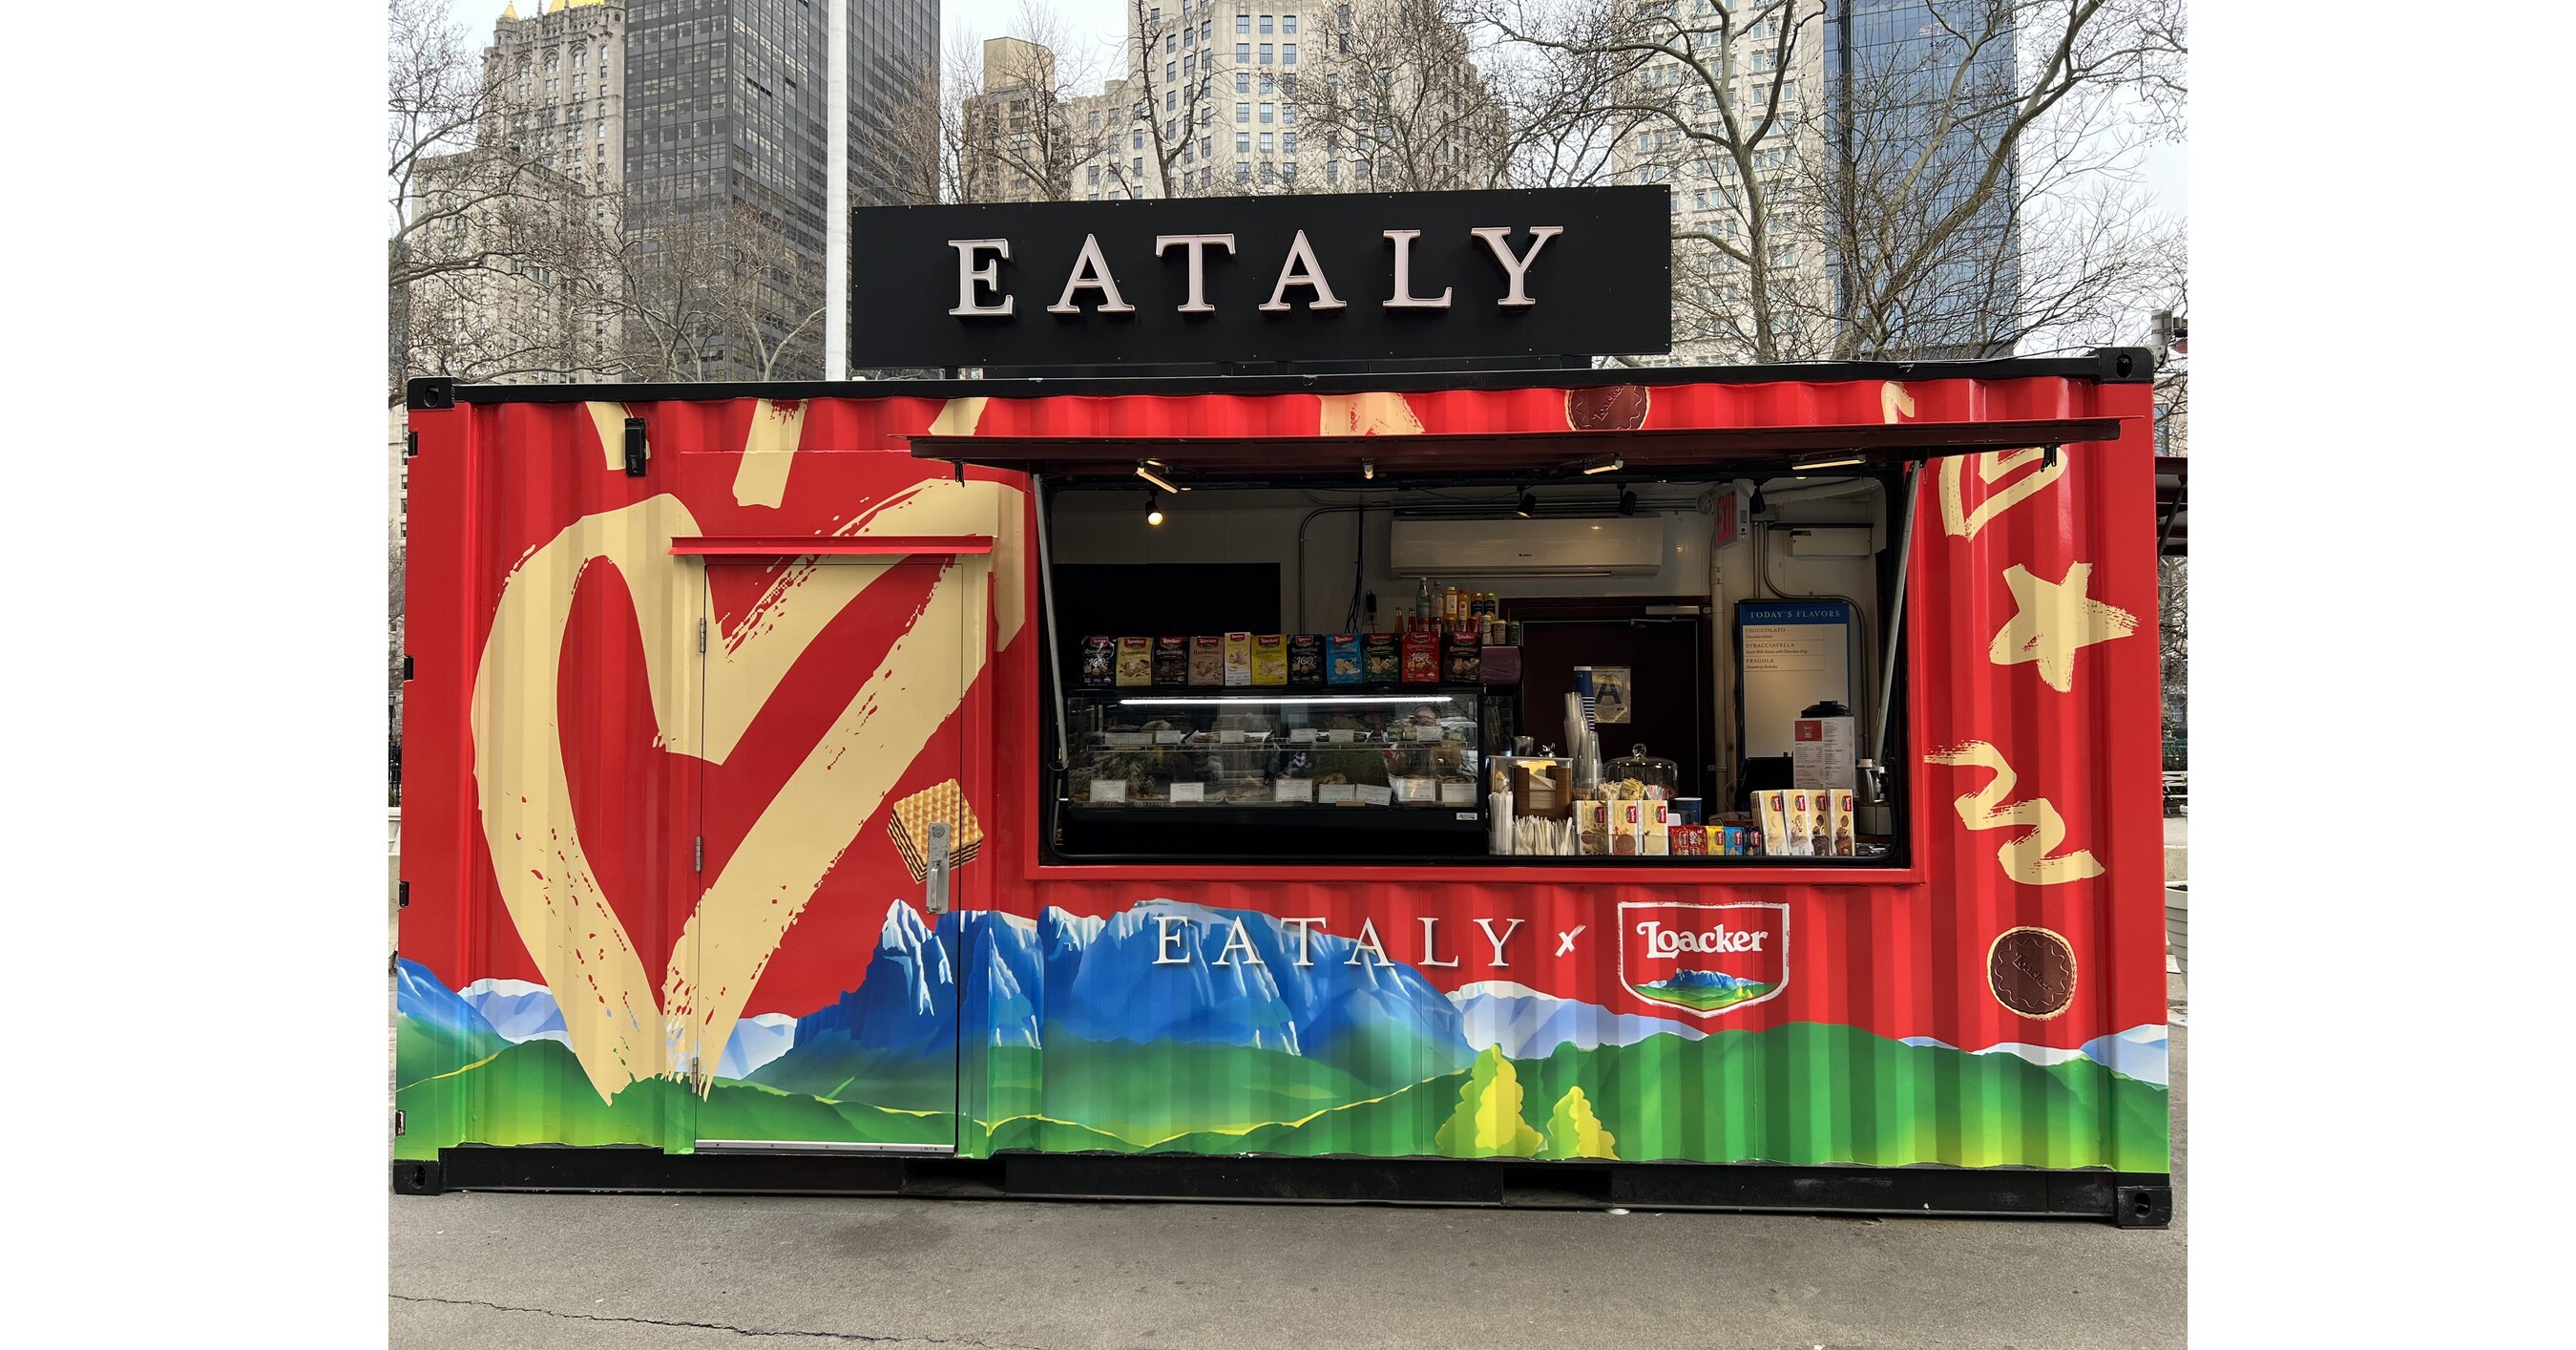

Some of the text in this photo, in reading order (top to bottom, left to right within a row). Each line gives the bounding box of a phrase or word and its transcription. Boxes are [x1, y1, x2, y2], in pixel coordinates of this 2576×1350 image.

[948, 225, 1564, 317] EATALY
[1591, 386, 1624, 421] Loacke
[1595, 674, 1622, 704] A
[1152, 916, 1525, 967] EATALY
[1636, 920, 1769, 960] Loacker
[2012, 951, 2053, 991] Loacker
